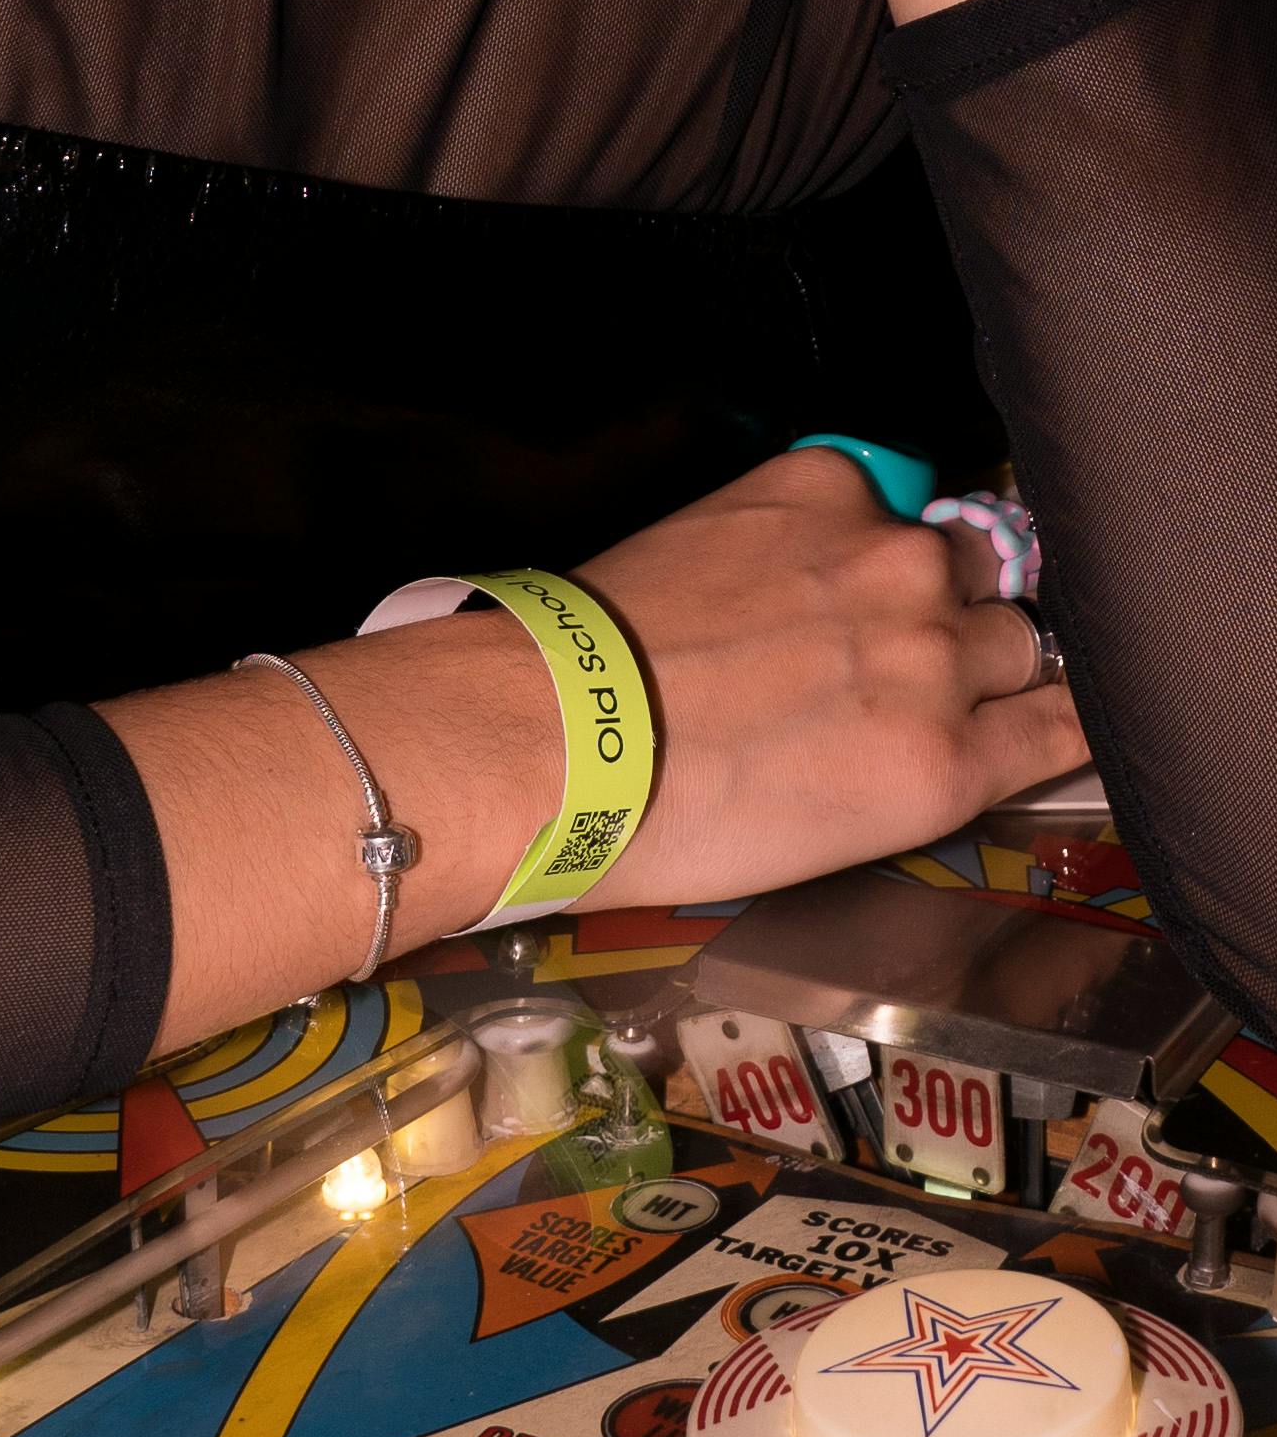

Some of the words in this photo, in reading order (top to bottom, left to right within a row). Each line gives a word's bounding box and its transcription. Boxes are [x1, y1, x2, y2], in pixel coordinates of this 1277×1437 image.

[588, 687, 625, 764] Old
[716, 1054, 816, 1134] 400
[892, 1058, 993, 1148] 300
[640, 1193, 699, 1223] HIT
[1070, 1132, 1187, 1237] 200
[507, 1230, 623, 1278] TARGET
[528, 1210, 644, 1259] SCORES
[801, 1210, 955, 1260] SCORES
[805, 1234, 907, 1273] 10X
[499, 1253, 589, 1295] VALUE
[715, 1235, 858, 1286] TARGET
